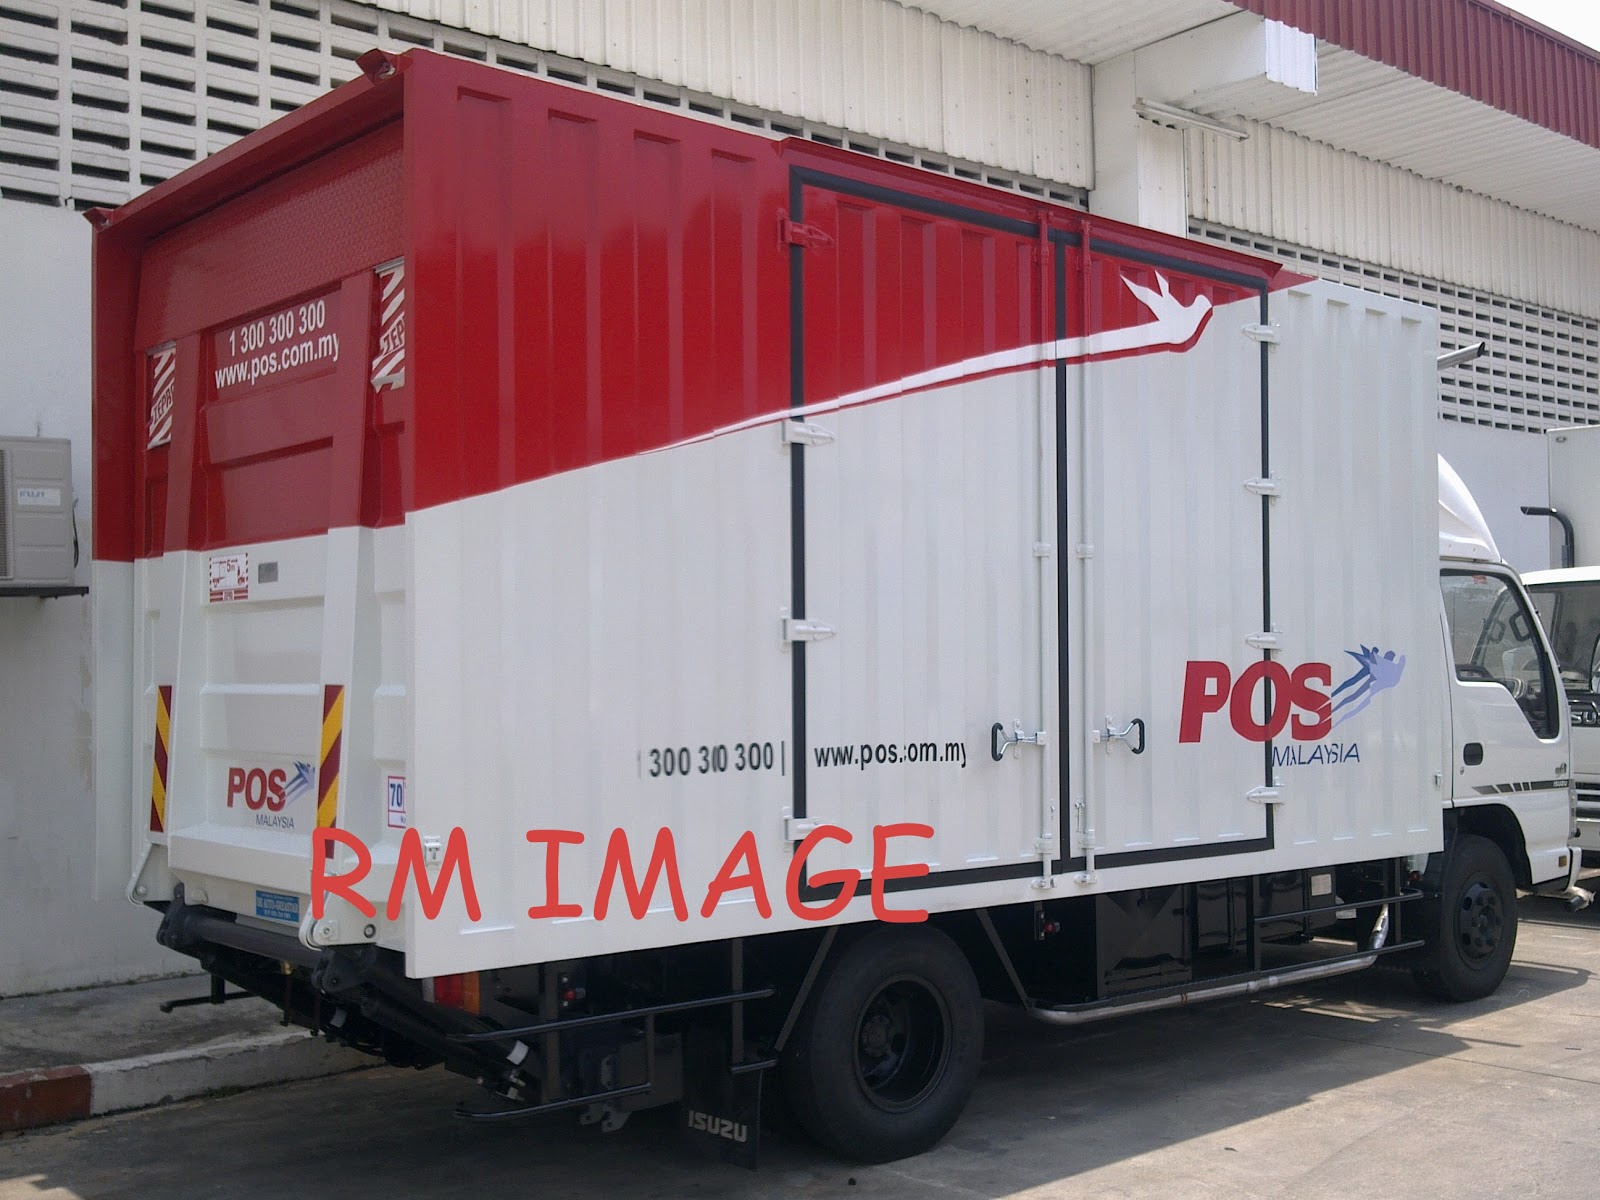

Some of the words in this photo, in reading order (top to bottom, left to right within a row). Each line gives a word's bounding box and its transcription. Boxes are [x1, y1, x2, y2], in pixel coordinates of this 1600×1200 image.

[229, 330, 236, 357] 1
[240, 321, 265, 354] 300
[269, 310, 294, 344] 300
[299, 299, 326, 335] 300
[214, 332, 339, 390] www.pos.com.my
[1178, 660, 1332, 744] POS
[650, 748, 691, 778] 300
[735, 742, 774, 771] 300
[813, 742, 967, 771] www.pos.om.my
[227, 767, 287, 812] POS
[390, 783, 403, 807] 70
[255, 814, 295, 829] MALAYSIA
[688, 1110, 747, 1142] ISUZU
